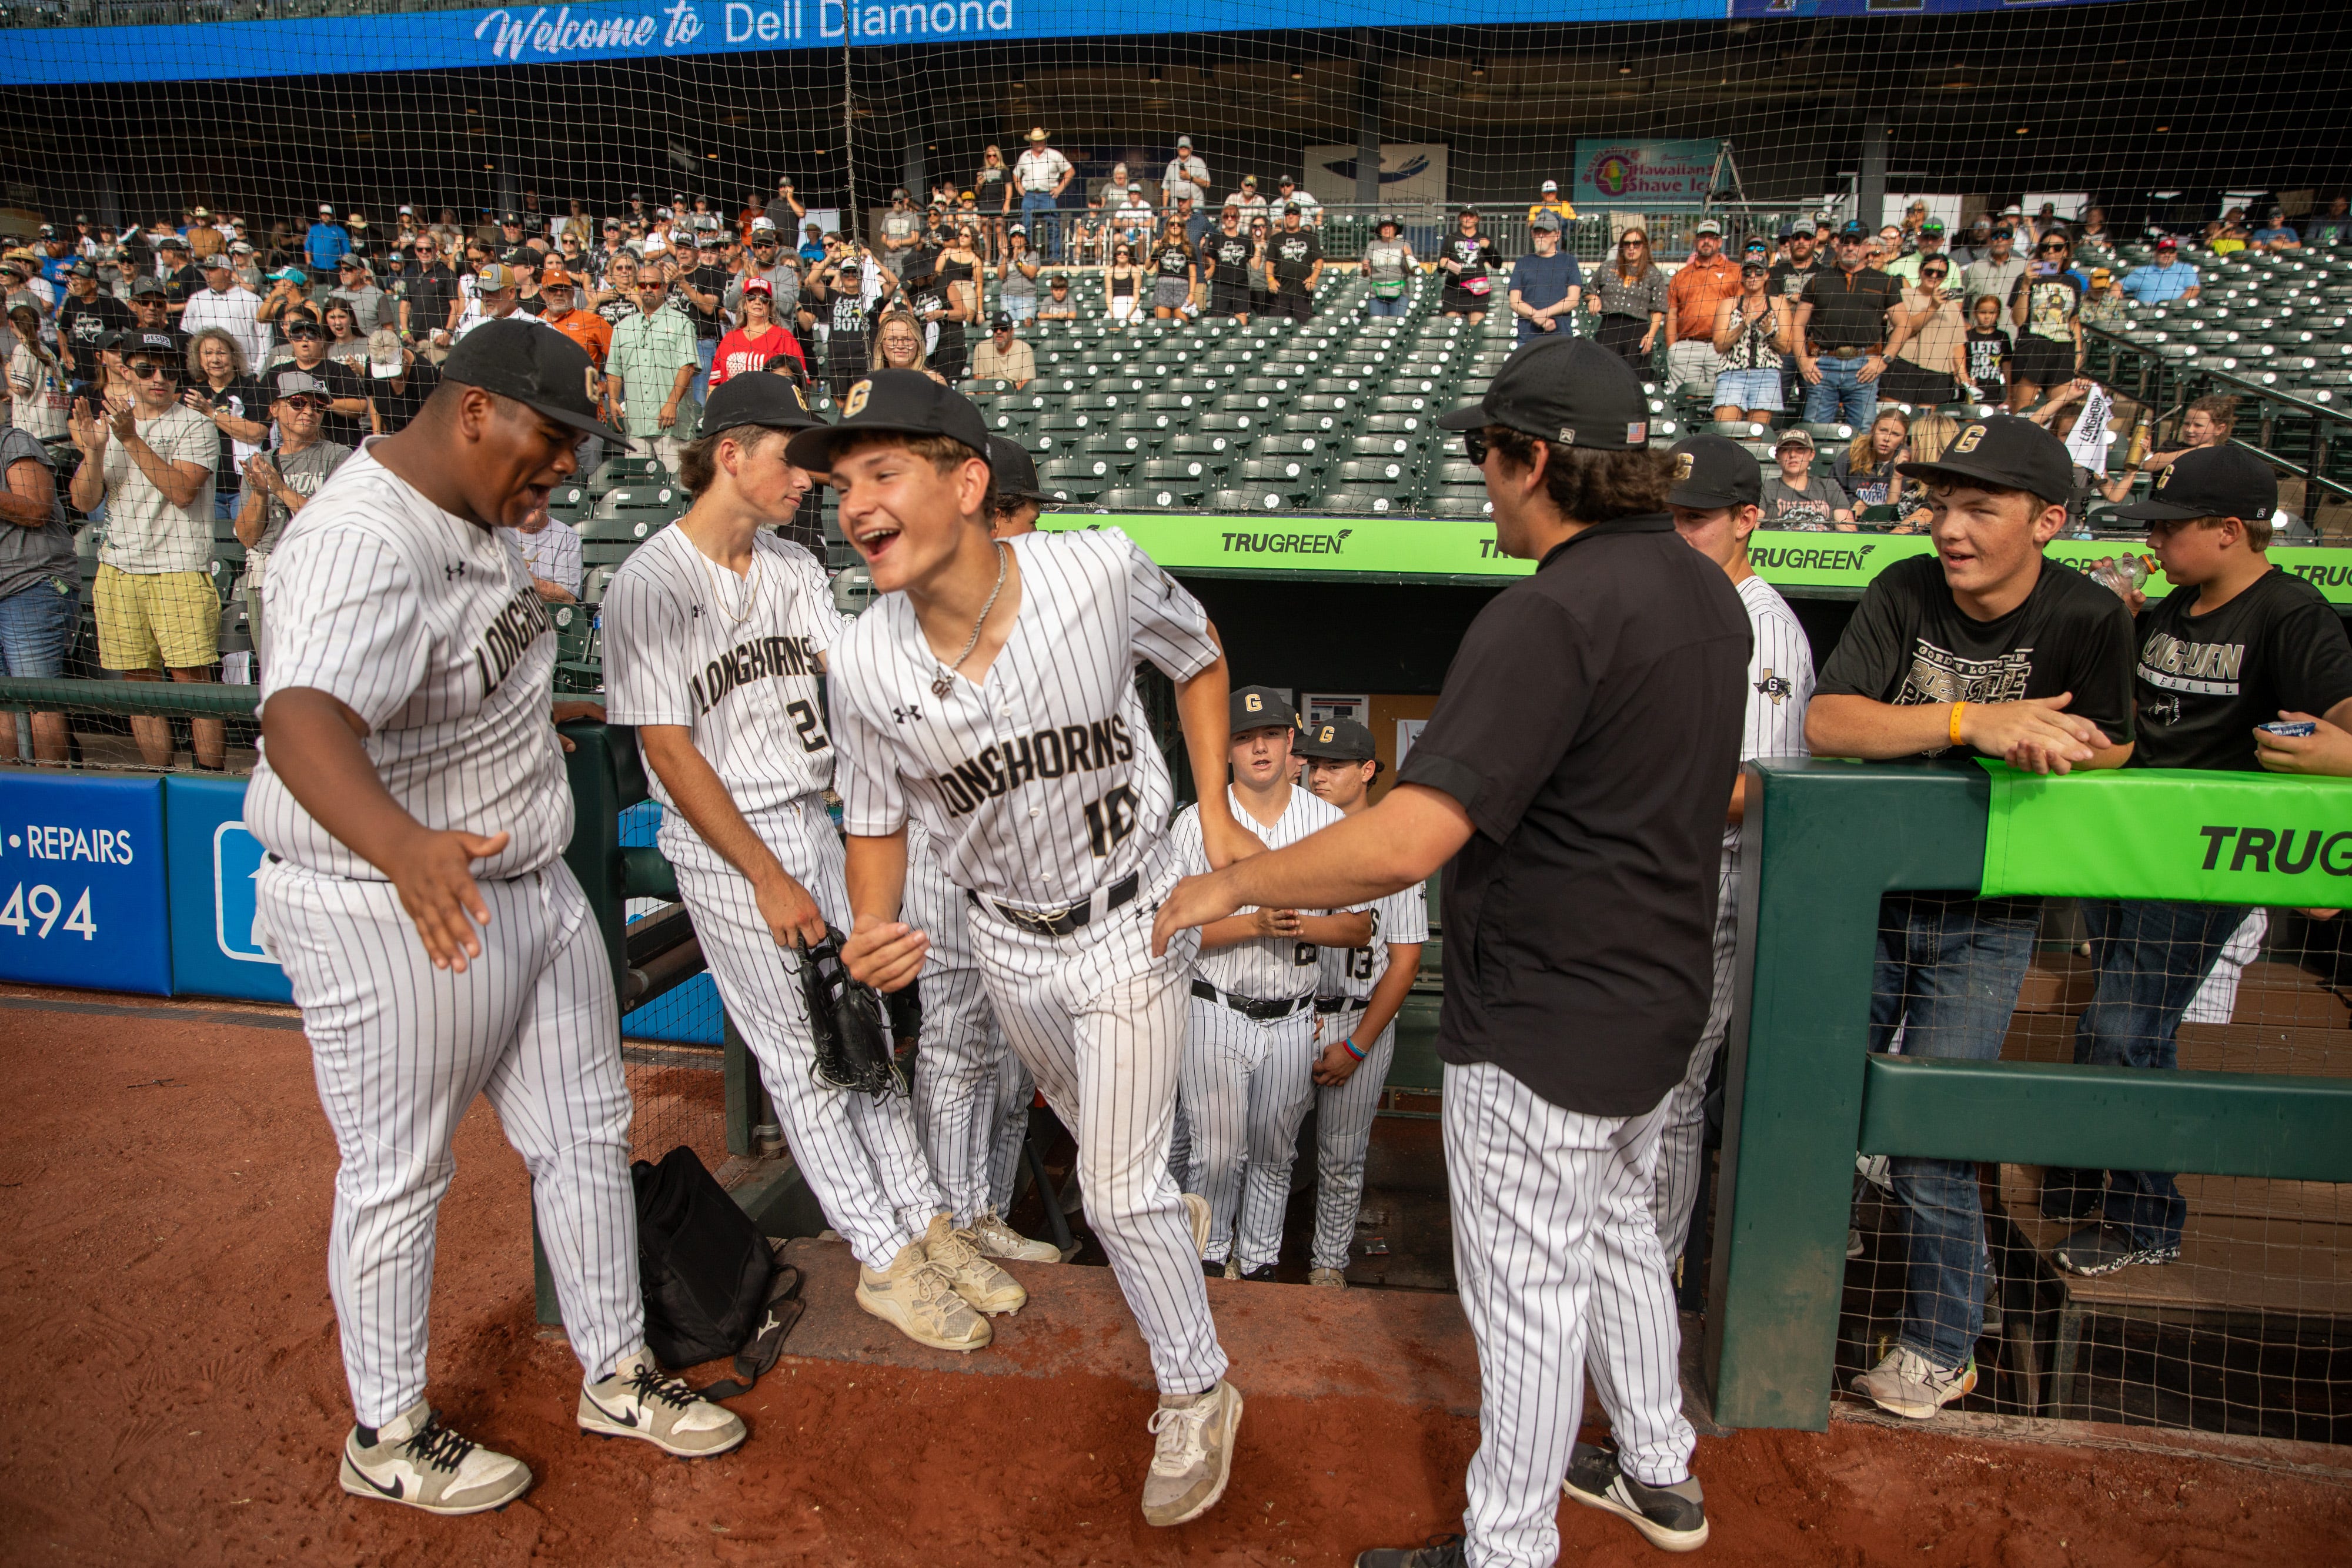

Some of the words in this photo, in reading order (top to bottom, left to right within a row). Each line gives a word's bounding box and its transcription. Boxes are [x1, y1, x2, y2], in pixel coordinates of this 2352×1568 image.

[475, 6, 657, 61] Welcome
[664, 0, 703, 48] to
[725, 0, 801, 44] Dell
[819, 0, 1013, 39] Diamond
[1628, 178, 1682, 192] Shave
[833, 305, 852, 318] GO
[145, 334, 171, 345] JESUS
[1970, 341, 2002, 354] LETS
[843, 379, 873, 418] G
[1954, 424, 1987, 453] G
[2156, 463, 2174, 490] G
[1856, 489, 1887, 504] AMERI
[1222, 532, 1343, 554] TRUGREEN
[1918, 646, 1964, 673] GORDN
[1969, 653, 2027, 675] LOGRN
[691, 636, 816, 717] LONGHORNS
[1768, 678, 1779, 691] G
[1245, 693, 1263, 713] G
[786, 698, 830, 753] 2
[1319, 726, 1335, 743] G
[931, 713, 1134, 818] LONGHORNS
[1083, 781, 1138, 858] 10
[27, 825, 133, 865] REPAIRS
[0, 881, 97, 941] 494
[1347, 946, 1374, 979] 13
